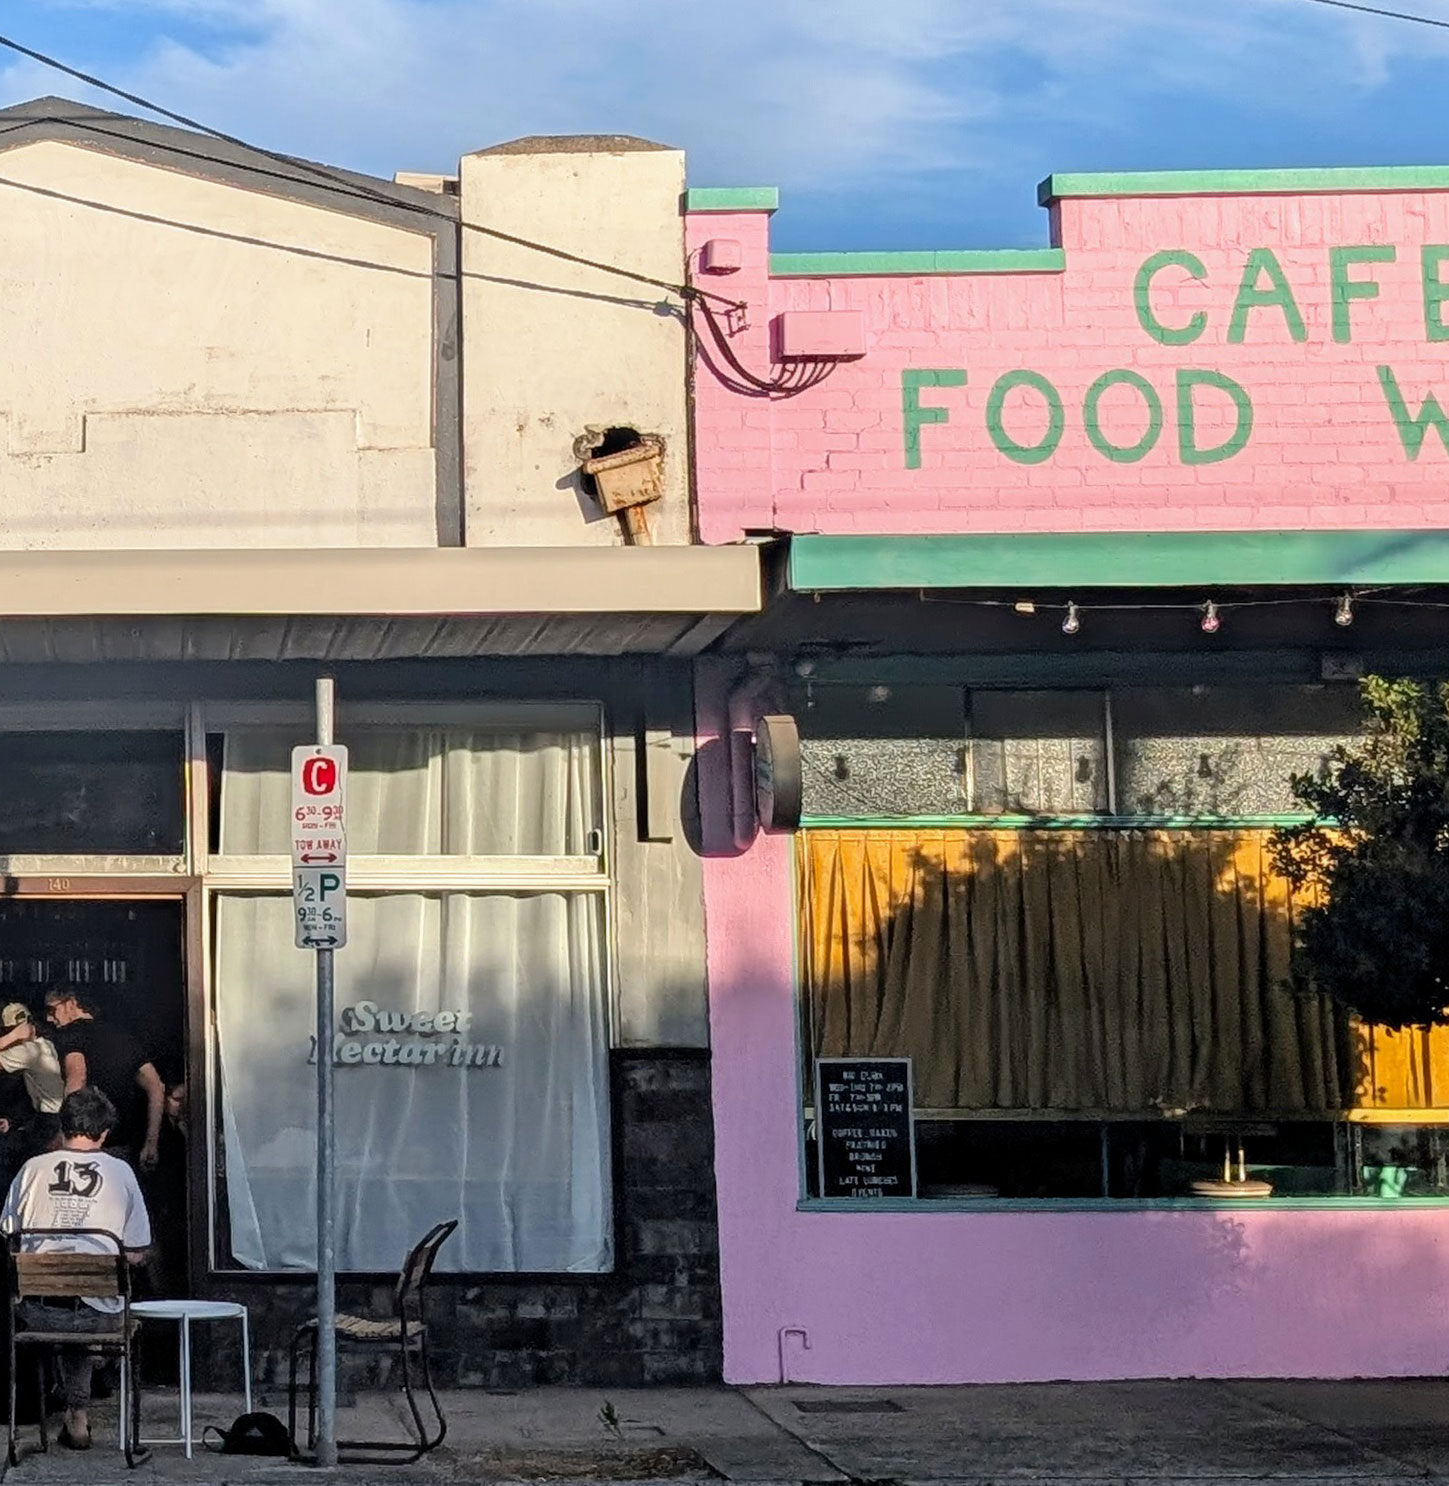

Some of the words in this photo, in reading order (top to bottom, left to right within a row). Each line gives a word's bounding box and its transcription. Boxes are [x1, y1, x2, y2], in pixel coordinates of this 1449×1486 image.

[902, 368, 1253, 469] FOOD
[311, 761, 328, 792] C
[316, 840, 341, 850] AWAY
[48, 878, 70, 891] 140
[320, 873, 340, 902] P
[351, 1000, 473, 1032] Sweet
[48, 1160, 103, 1198] 13
